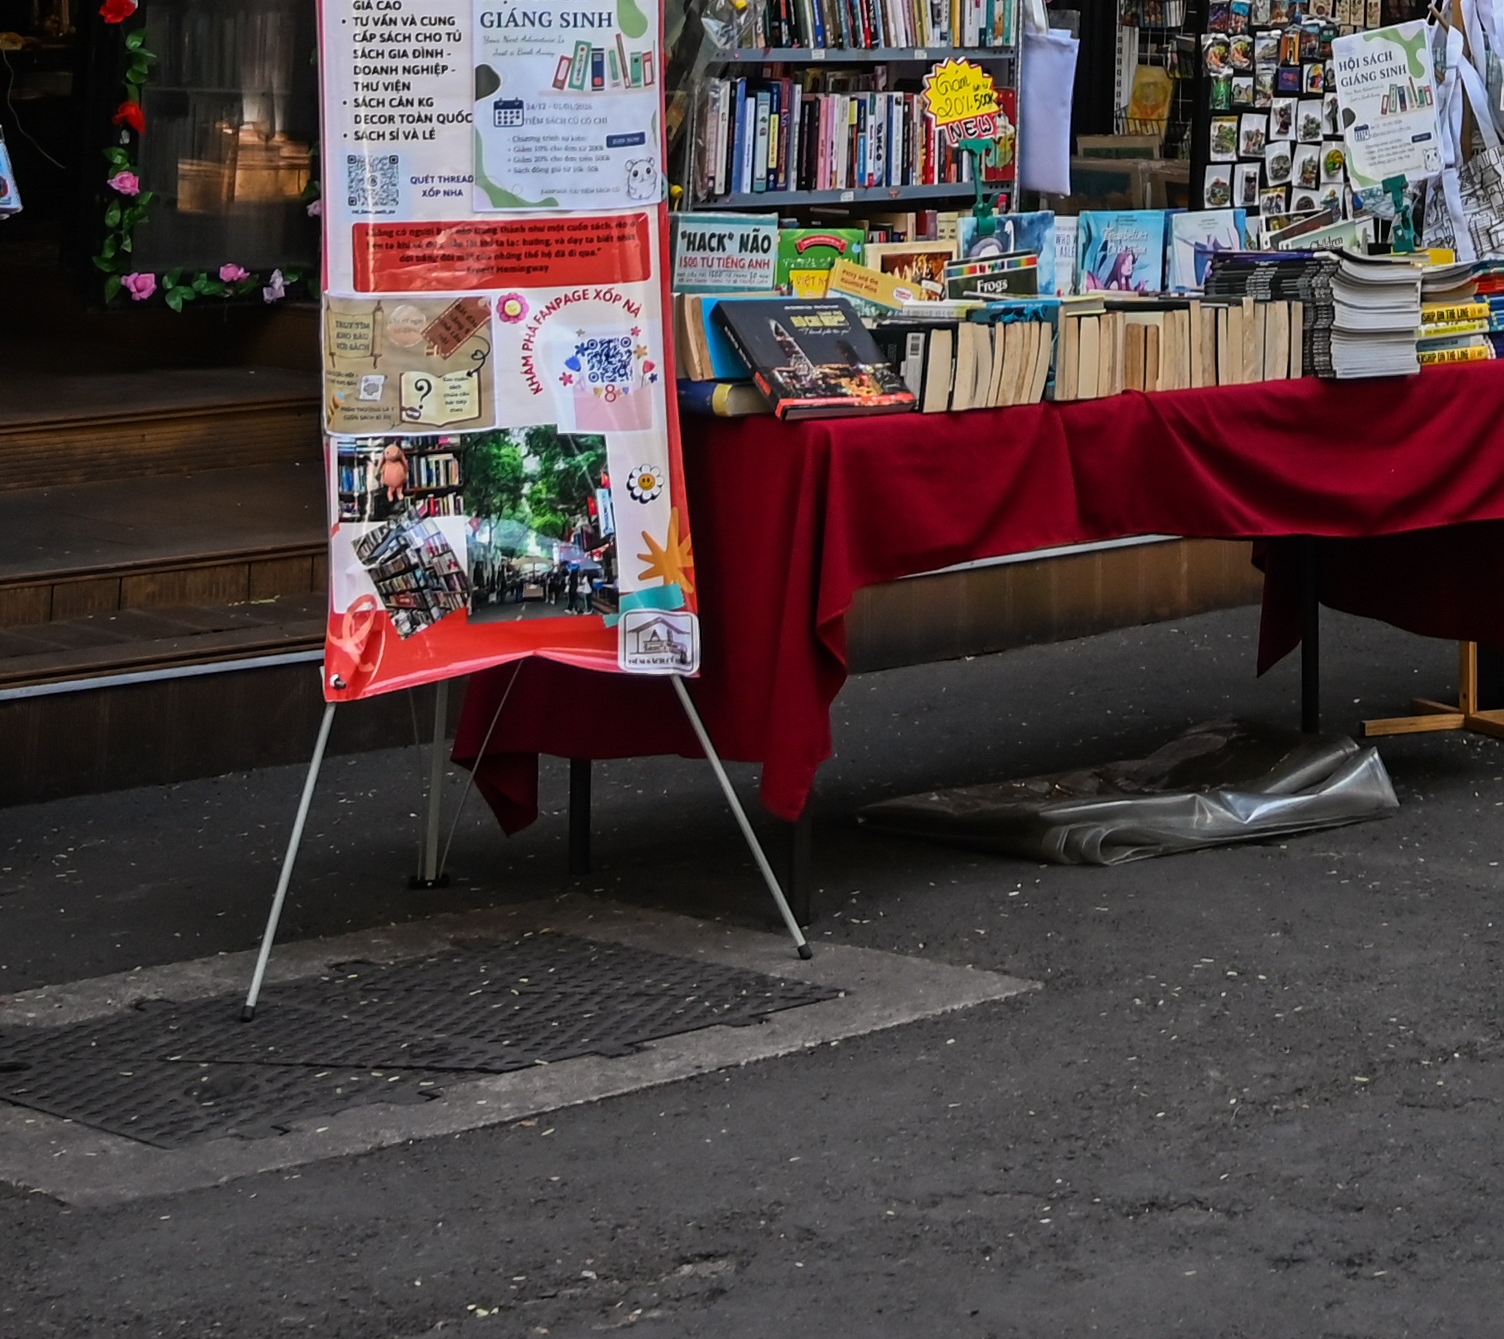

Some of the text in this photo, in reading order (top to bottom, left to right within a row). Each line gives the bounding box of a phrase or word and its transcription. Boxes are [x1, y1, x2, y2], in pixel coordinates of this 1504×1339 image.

[376, 1, 402, 11] CAO
[353, 13, 456, 27] TƯ VẤN VÀ CUNG
[480, 8, 614, 29] GIÁNG SINH
[353, 30, 462, 43] CẤP SÁCH CHO TỦ
[353, 47, 444, 60] SÁCH GIA ĐÌNH
[1339, 51, 1394, 72] HỘI SÁCH
[353, 63, 449, 77] DOANH NGHIỆP
[1340, 64, 1408, 87] GIÁNG SINH
[353, 80, 411, 93] THƯ VIỆN
[353, 96, 386, 108] SÁCH
[417, 98, 434, 108] KG
[354, 110, 474, 125] DECOR TOÀN QUỐC
[402, 128, 419, 140] VÀ
[949, 116, 992, 141] NEW
[438, 175, 474, 184] THREAD
[738, 227, 771, 253] NÃO
[718, 254, 746, 270] TIẾNG
[748, 257, 770, 269] ANH
[976, 278, 1008, 294] Frogs
[533, 287, 590, 325] FANPAGE
